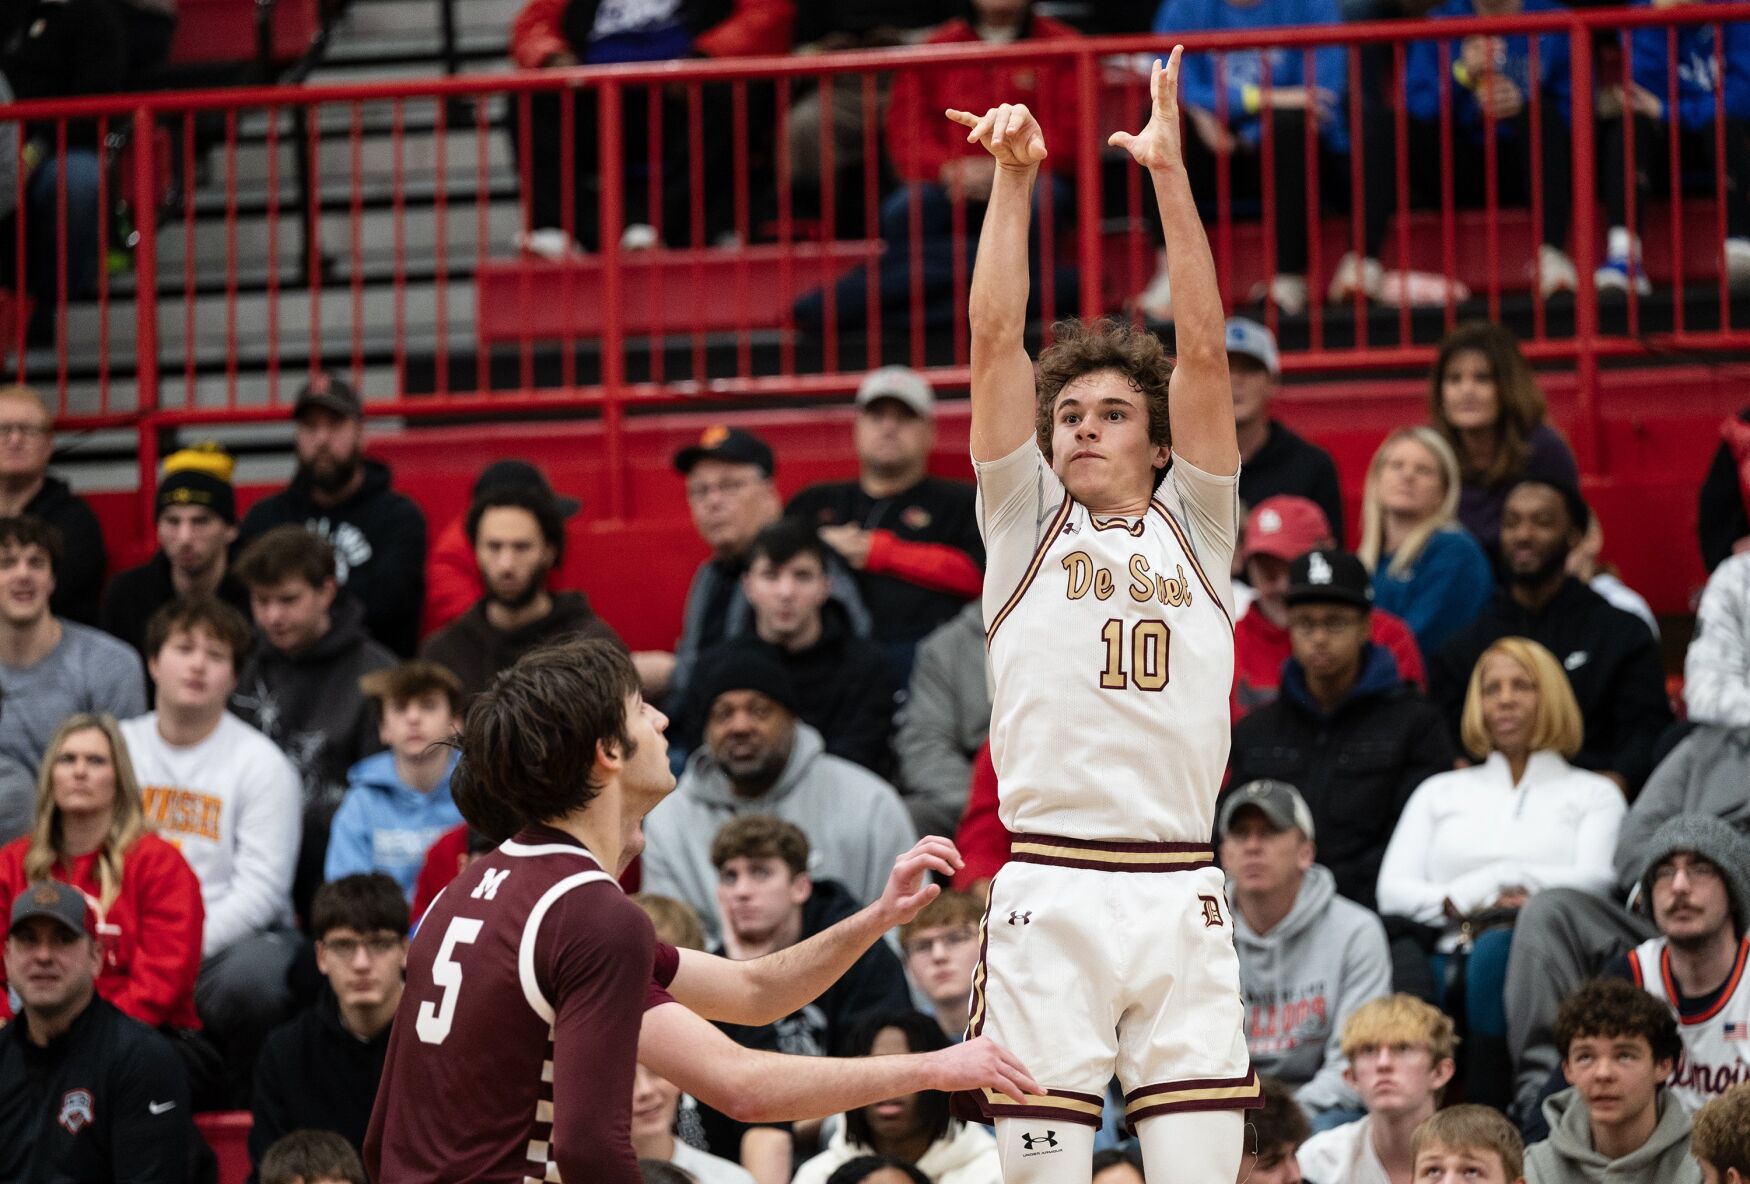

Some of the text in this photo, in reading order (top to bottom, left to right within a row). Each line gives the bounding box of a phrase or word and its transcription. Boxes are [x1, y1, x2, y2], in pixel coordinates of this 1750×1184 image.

[1061, 551, 1115, 601] De
[1100, 618, 1171, 692] 10
[470, 867, 511, 900] M
[415, 916, 485, 1045] 5
